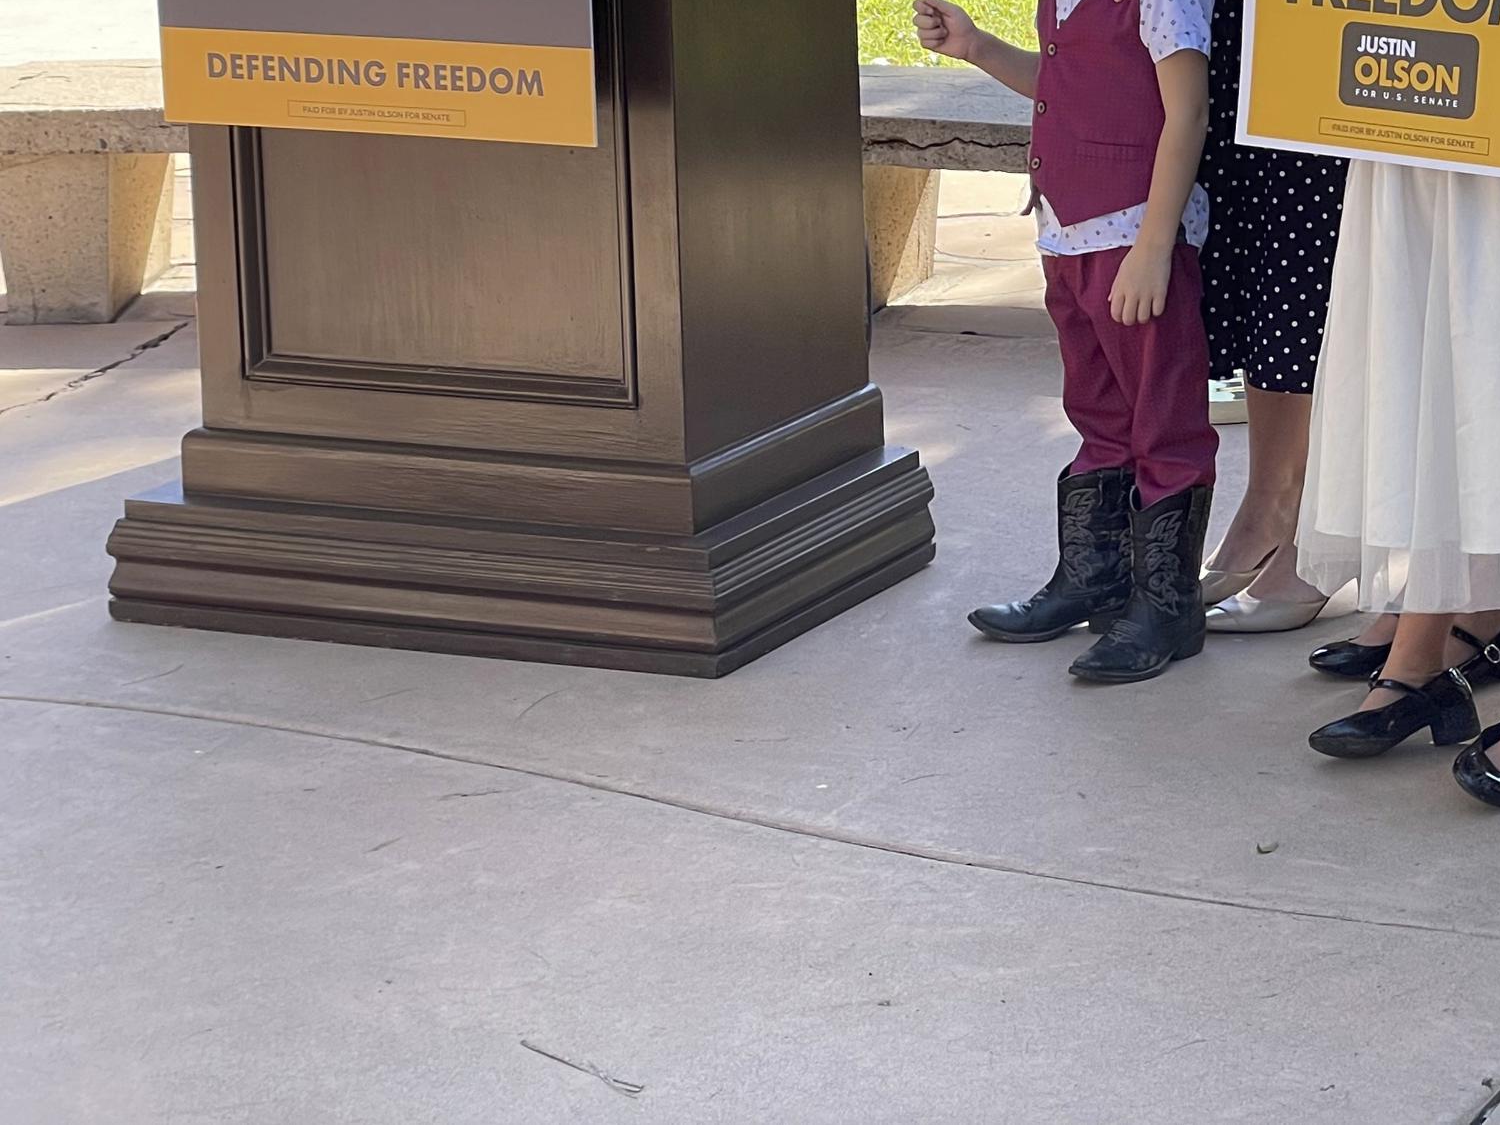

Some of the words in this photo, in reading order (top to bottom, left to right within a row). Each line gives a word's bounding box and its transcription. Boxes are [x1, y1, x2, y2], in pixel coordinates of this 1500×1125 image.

[1356, 35, 1416, 58] JUSTIN
[206, 51, 387, 88] DEFENDING
[396, 62, 545, 97] FREEDOM
[1354, 55, 1460, 95] OLSON
[1355, 88, 1376, 98] FOR
[1383, 91, 1407, 103] U.S.
[1413, 95, 1458, 108] SENATE
[303, 106, 319, 114] PAID
[321, 107, 336, 115] FOR
[338, 108, 348, 116] BY
[349, 109, 375, 118] JUSTIN
[377, 110, 404, 119] OLSON
[405, 112, 420, 120] FOR
[421, 113, 450, 122] SENATE
[1332, 123, 1348, 133] PAID
[1350, 126, 1365, 136] FOR
[1366, 128, 1377, 137] BY
[1376, 129, 1402, 140] JUSTIN
[1403, 132, 1429, 144] OLSON
[1430, 136, 1446, 146] FOR
[1447, 138, 1475, 150] SENATE
